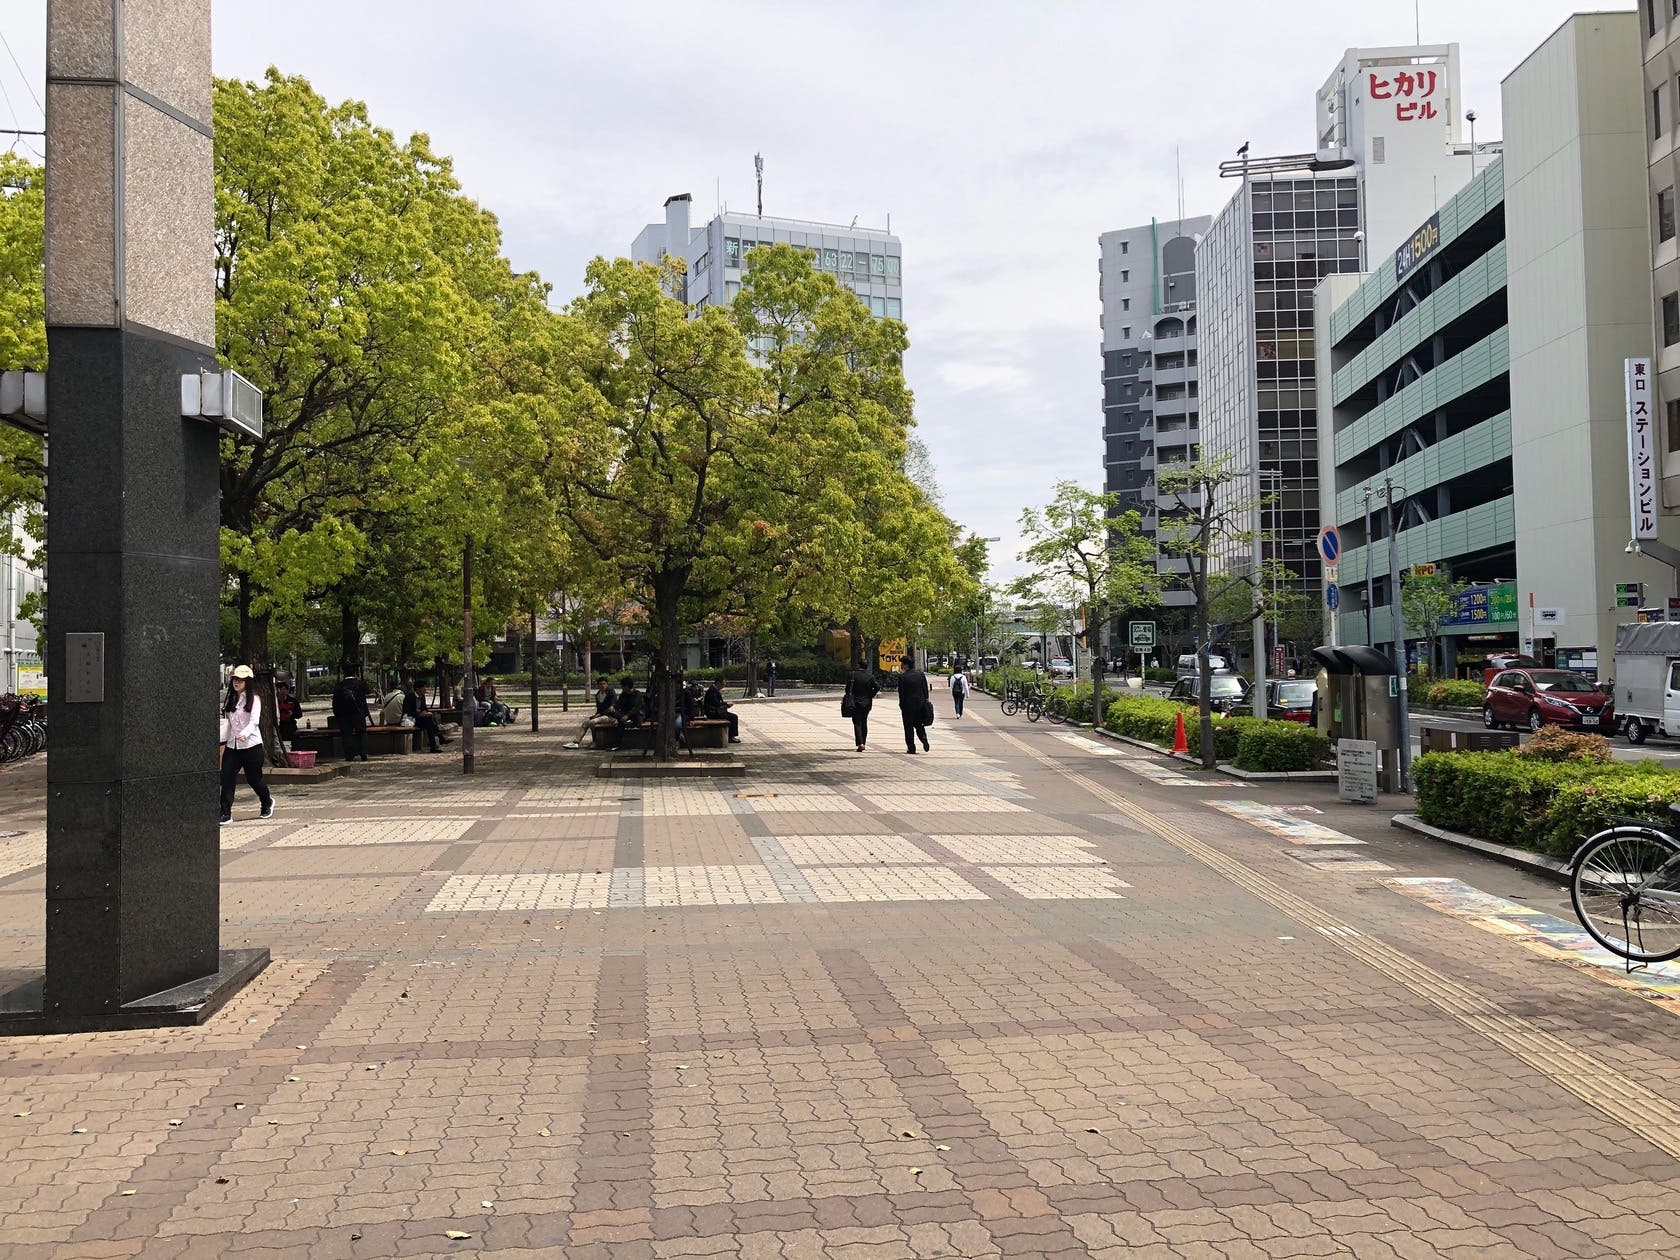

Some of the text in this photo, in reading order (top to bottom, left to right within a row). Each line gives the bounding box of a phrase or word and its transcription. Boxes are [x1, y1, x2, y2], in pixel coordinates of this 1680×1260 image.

[1369, 70, 1437, 99] ヒカリ
[1396, 101, 1438, 121] ビル
[1397, 223, 1438, 275] 24H 1500円
[1634, 363, 1653, 531] 東口 ステーションビル
